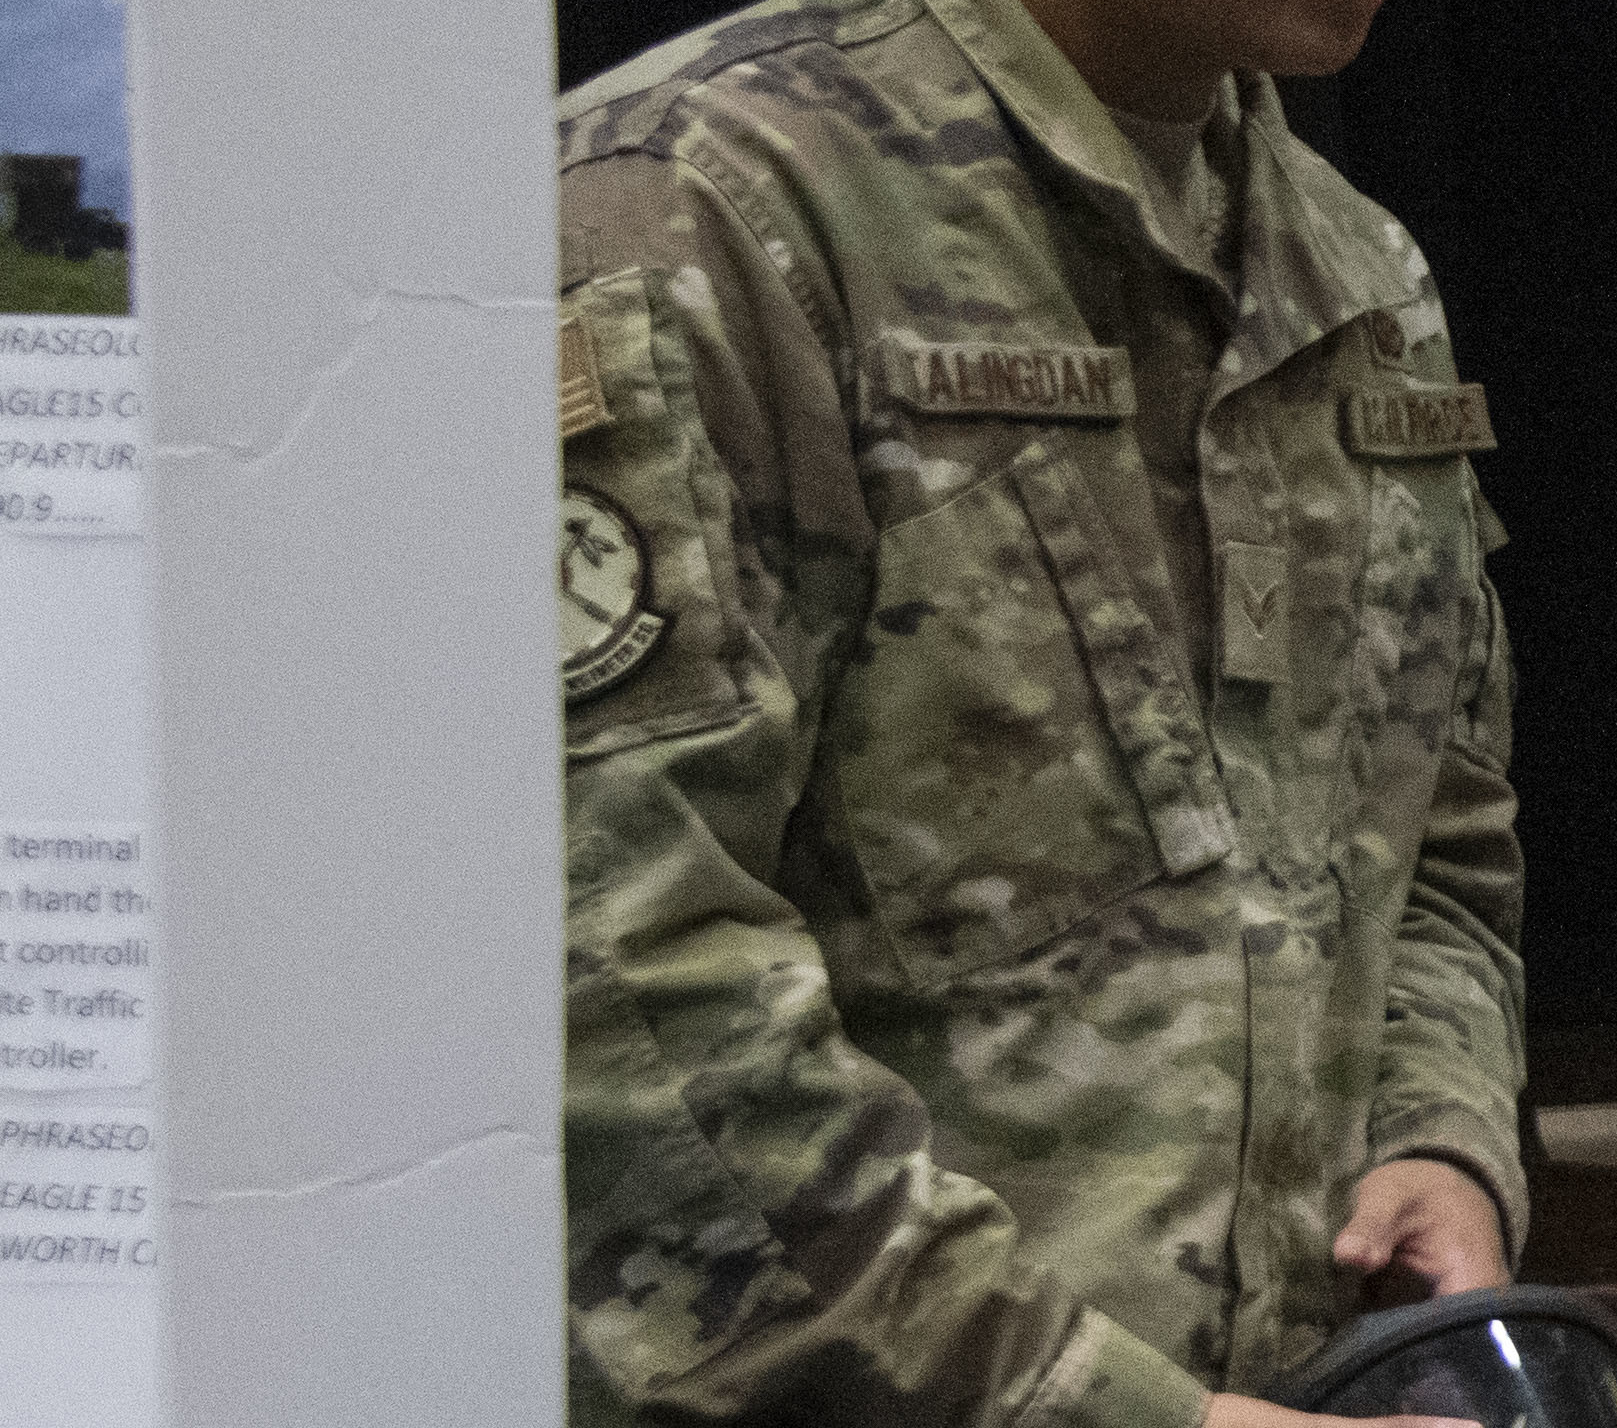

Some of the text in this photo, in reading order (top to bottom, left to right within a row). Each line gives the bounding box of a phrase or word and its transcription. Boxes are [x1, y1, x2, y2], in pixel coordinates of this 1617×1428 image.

[0, 388, 142, 419] GLE15 C
[6, 834, 141, 862] terminal
[43, 988, 145, 1019] Traffic
[0, 1120, 156, 1152] PHRASEO
[0, 1181, 103, 1213] EAGLE
[0, 1235, 158, 1267] WORTH C
